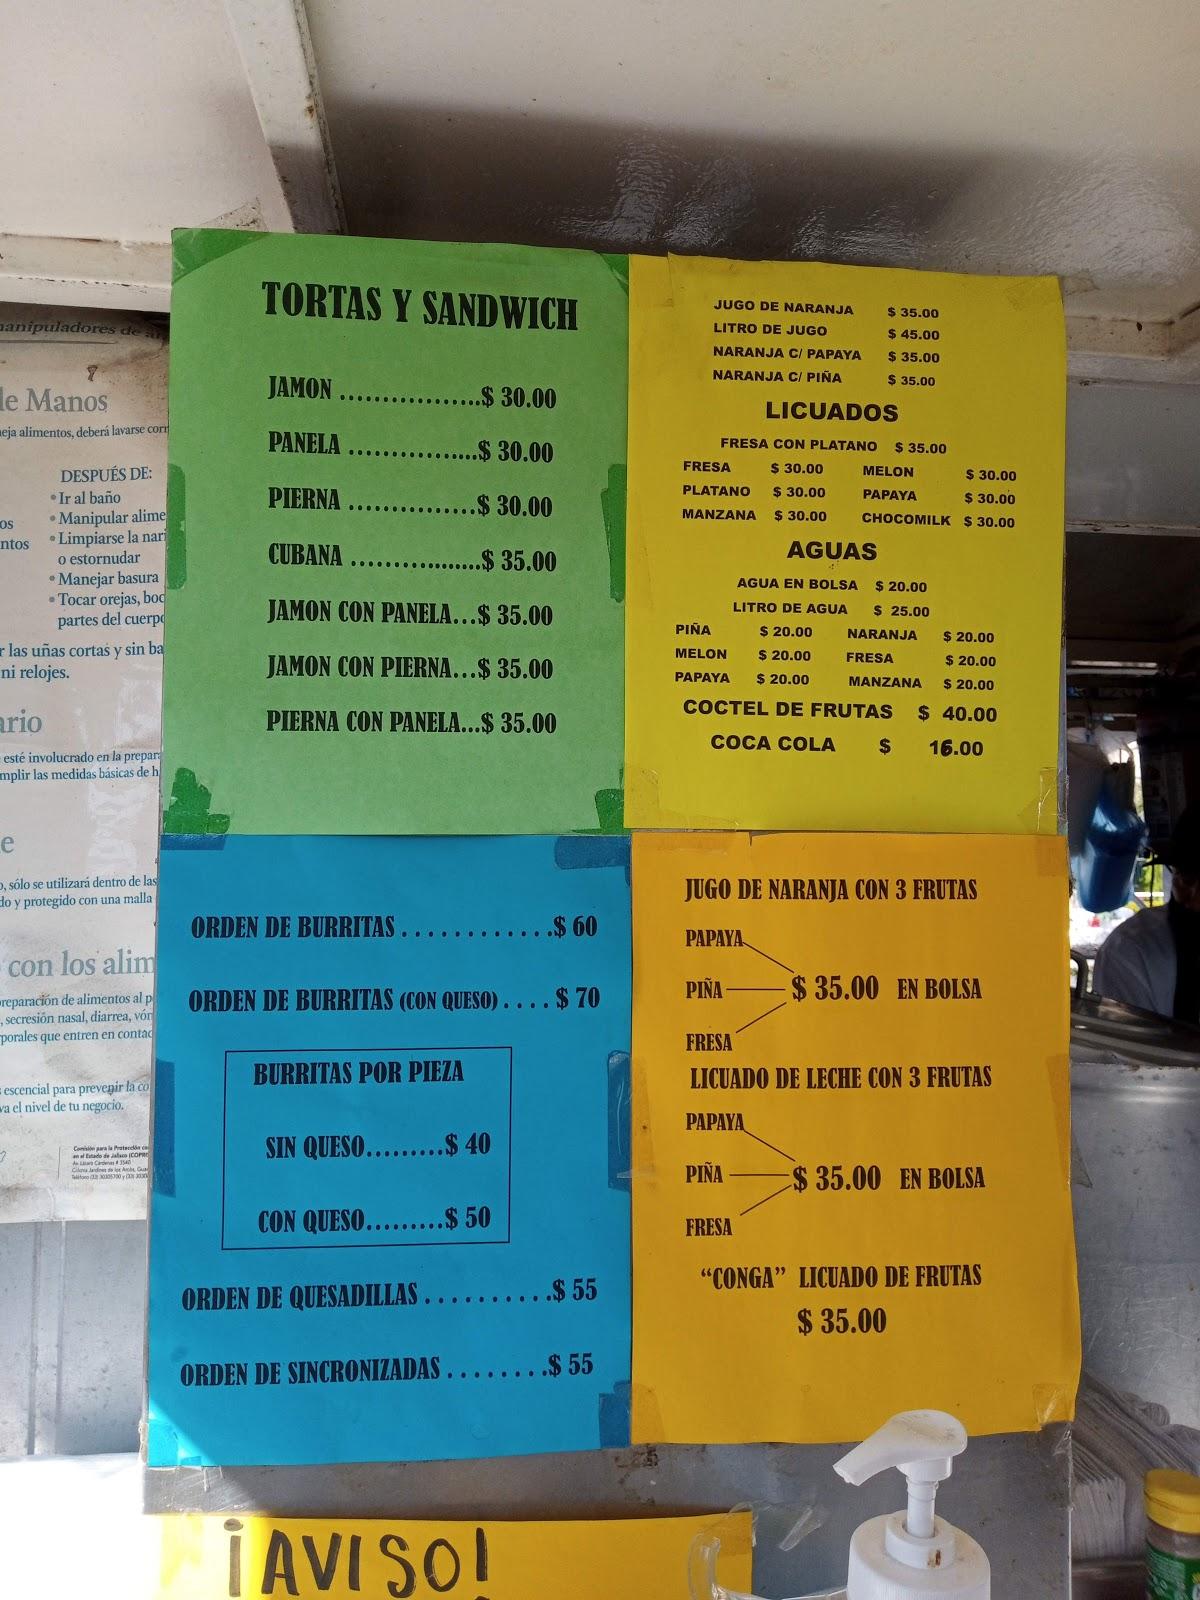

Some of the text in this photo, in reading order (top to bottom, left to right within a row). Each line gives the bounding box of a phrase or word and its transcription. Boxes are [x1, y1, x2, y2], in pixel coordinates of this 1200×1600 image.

[262, 281, 578, 331] TORTAS Y SANDWICH
[714, 300, 853, 315] JUGO DE NARANJA
[714, 323, 939, 341] LITRO DE JUGO 45.00
[713, 346, 862, 361] NARANJA C/ PAPAYA
[712, 369, 842, 383] NARANJA C/ PIÑA
[25, 387, 108, 412] Manos
[268, 376, 557, 408] JAMON 30.00
[766, 401, 899, 422] LICUADOS
[19, 425, 145, 440] alimentos, deberá lavarse
[268, 431, 553, 463] PANELA 30.00
[720, 437, 878, 451] FRESA CON PLATANO
[61, 466, 152, 483] DESPUÉS DE:
[683, 461, 731, 473] FRESA
[863, 465, 914, 477] MELON
[59, 490, 121, 504] Ir al baño
[683, 485, 751, 497] PLATANO
[863, 489, 917, 501] PAPAYA
[268, 487, 552, 517] PIERNA 30.00
[59, 510, 129, 527] Manipular
[682, 508, 756, 520] MANZANA
[862, 512, 951, 526] CHOCOMILK
[59, 532, 125, 548] Limpiarse
[70, 552, 140, 565] estornudar
[269, 543, 557, 572] CUBANA 35.00
[787, 541, 877, 561] AGUAS
[58, 571, 159, 590] Manejar basura
[737, 577, 858, 591] AGUA EN BOLSA
[58, 592, 141, 608] Tocar orejas,
[267, 599, 553, 626] JAMON CON 35.00
[733, 602, 930, 617] LITRO DE AGUA 25.00
[58, 612, 121, 630] partes del
[675, 622, 711, 635] PIÑA
[847, 628, 918, 641] NARANJA
[9, 642, 145, 658] las uñas cortas sin
[675, 648, 727, 660] MELON
[846, 652, 894, 664] FRESA
[1, 665, 70, 682] ni relojes.
[675, 672, 730, 684] PAPAYA
[849, 676, 922, 689] MANZANA
[683, 700, 893, 719] COCTEL DE FRUTAS
[711, 735, 771, 751] COCA
[778, 736, 836, 752] COLA
[4, 751, 94, 764] esté involucrado
[51, 765, 133, 780] medidas básicas
[9, 874, 157, 890] sólo utilizará dentro las
[685, 878, 977, 902] JUGO DE NARANJA CON 3 FRUTAS
[24, 893, 152, 910] protegido malla
[191, 915, 395, 939] ORDEN DE BURRITAS
[686, 930, 743, 947] PAPAYA
[8, 950, 96, 978] con los
[686, 977, 723, 999] PIÑA
[815, 975, 982, 1000] 35.00 EN BOLSA
[77, 992, 130, 1006] alimentos
[189, 989, 256, 1013] ORDEN
[263, 990, 289, 1012] DE
[296, 988, 393, 1012] BURRITAS
[400, 991, 436, 1013] (CON
[576, 987, 600, 1009] 70
[5, 1009, 131, 1026] secresión nasal, diarrea,
[40, 1029, 99, 1045] que entren
[686, 1033, 733, 1051] FRESA
[253, 1060, 464, 1085] BURRITAS POR PIEZA
[690, 1065, 992, 1089] LICUADO DE LECHE CON 3 FRUTAS
[4, 1082, 124, 1098] escencial para prevenir
[25, 1099, 124, 1114] nivel negocio.
[800, 1266, 878, 1288] LICUADO
[885, 1266, 909, 1287] DE
[915, 1264, 982, 1287] FRUTAS
[182, 1282, 418, 1312] ORDEN DE QUESADILLAS
[821, 1307, 887, 1334] 35.00
[180, 1357, 441, 1387] ORDEN DE SINCRONIZADAS
